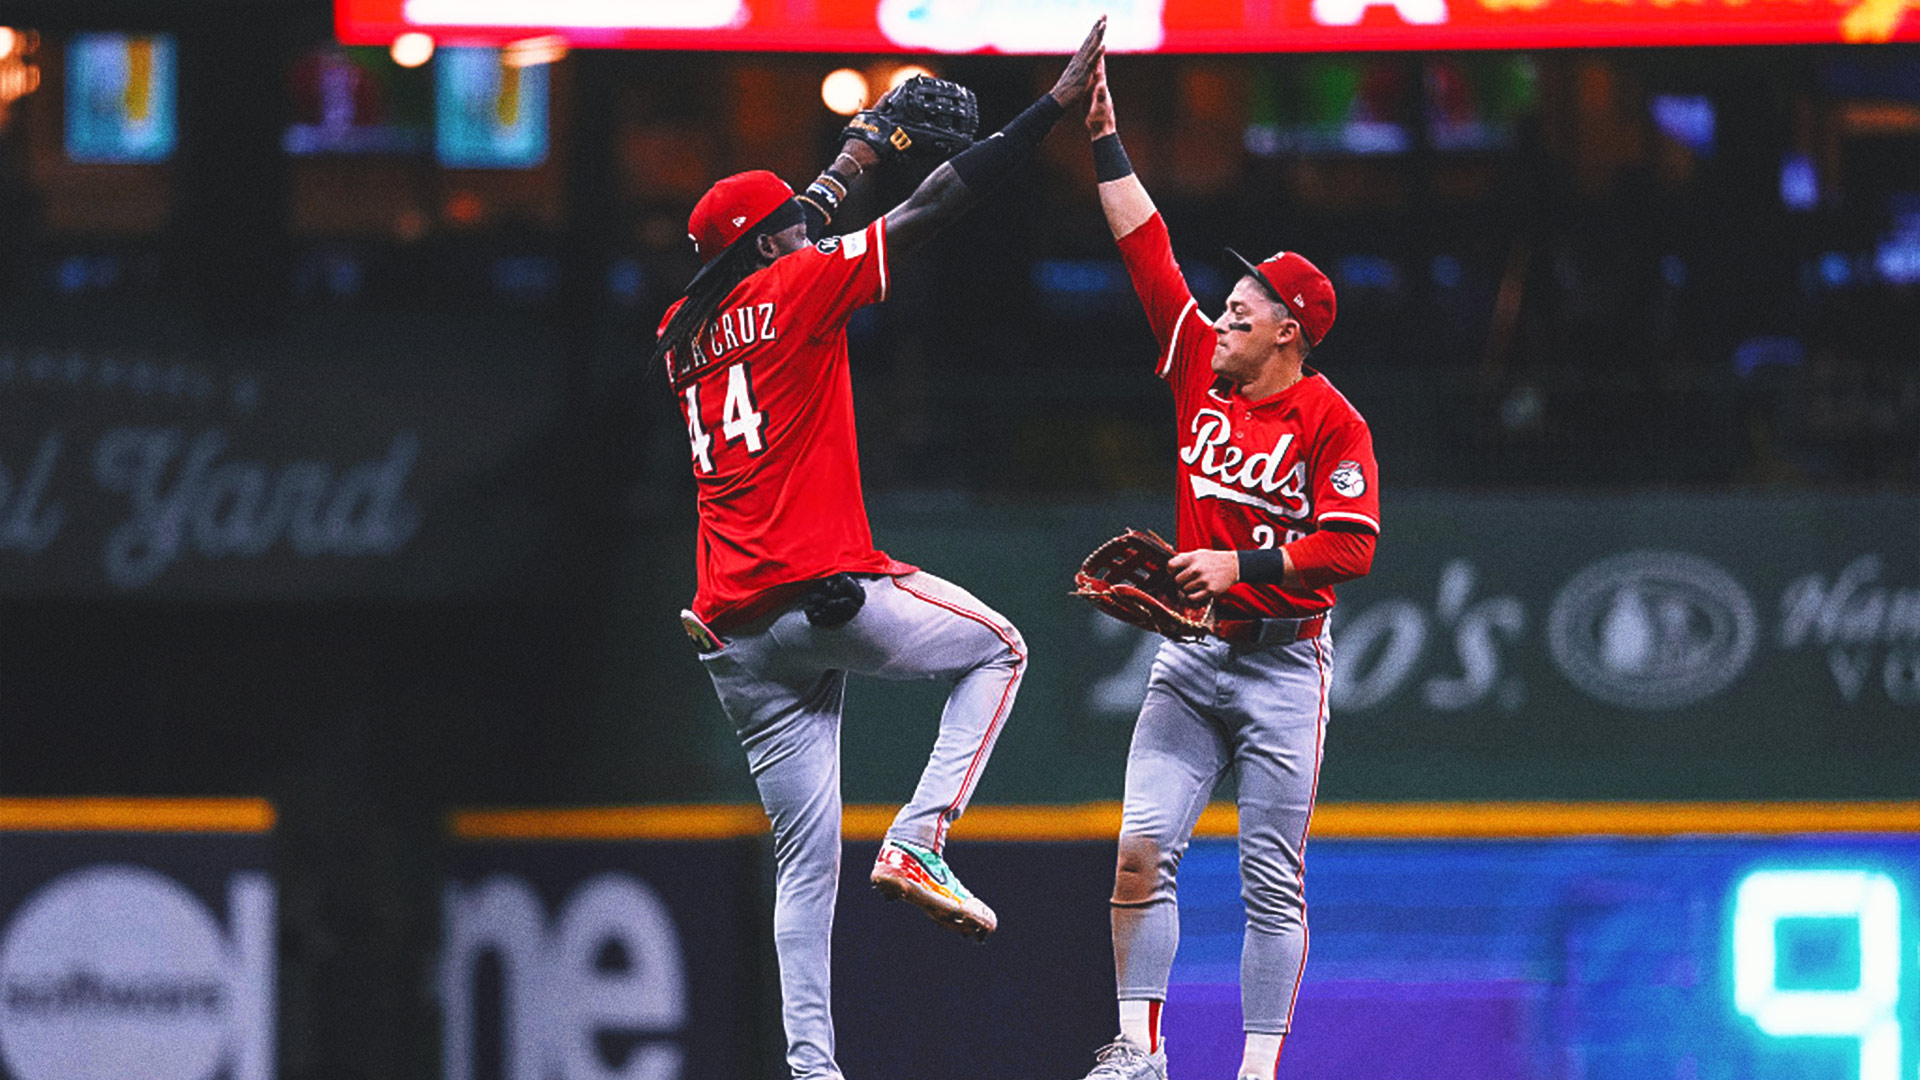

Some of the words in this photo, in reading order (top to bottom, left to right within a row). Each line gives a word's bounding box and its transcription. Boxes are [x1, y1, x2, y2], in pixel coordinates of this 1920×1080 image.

[708, 302, 776, 357] CRUZ
[685, 362, 763, 474] 44
[1180, 408, 1310, 519] Reds
[93, 424, 424, 588] Yard
